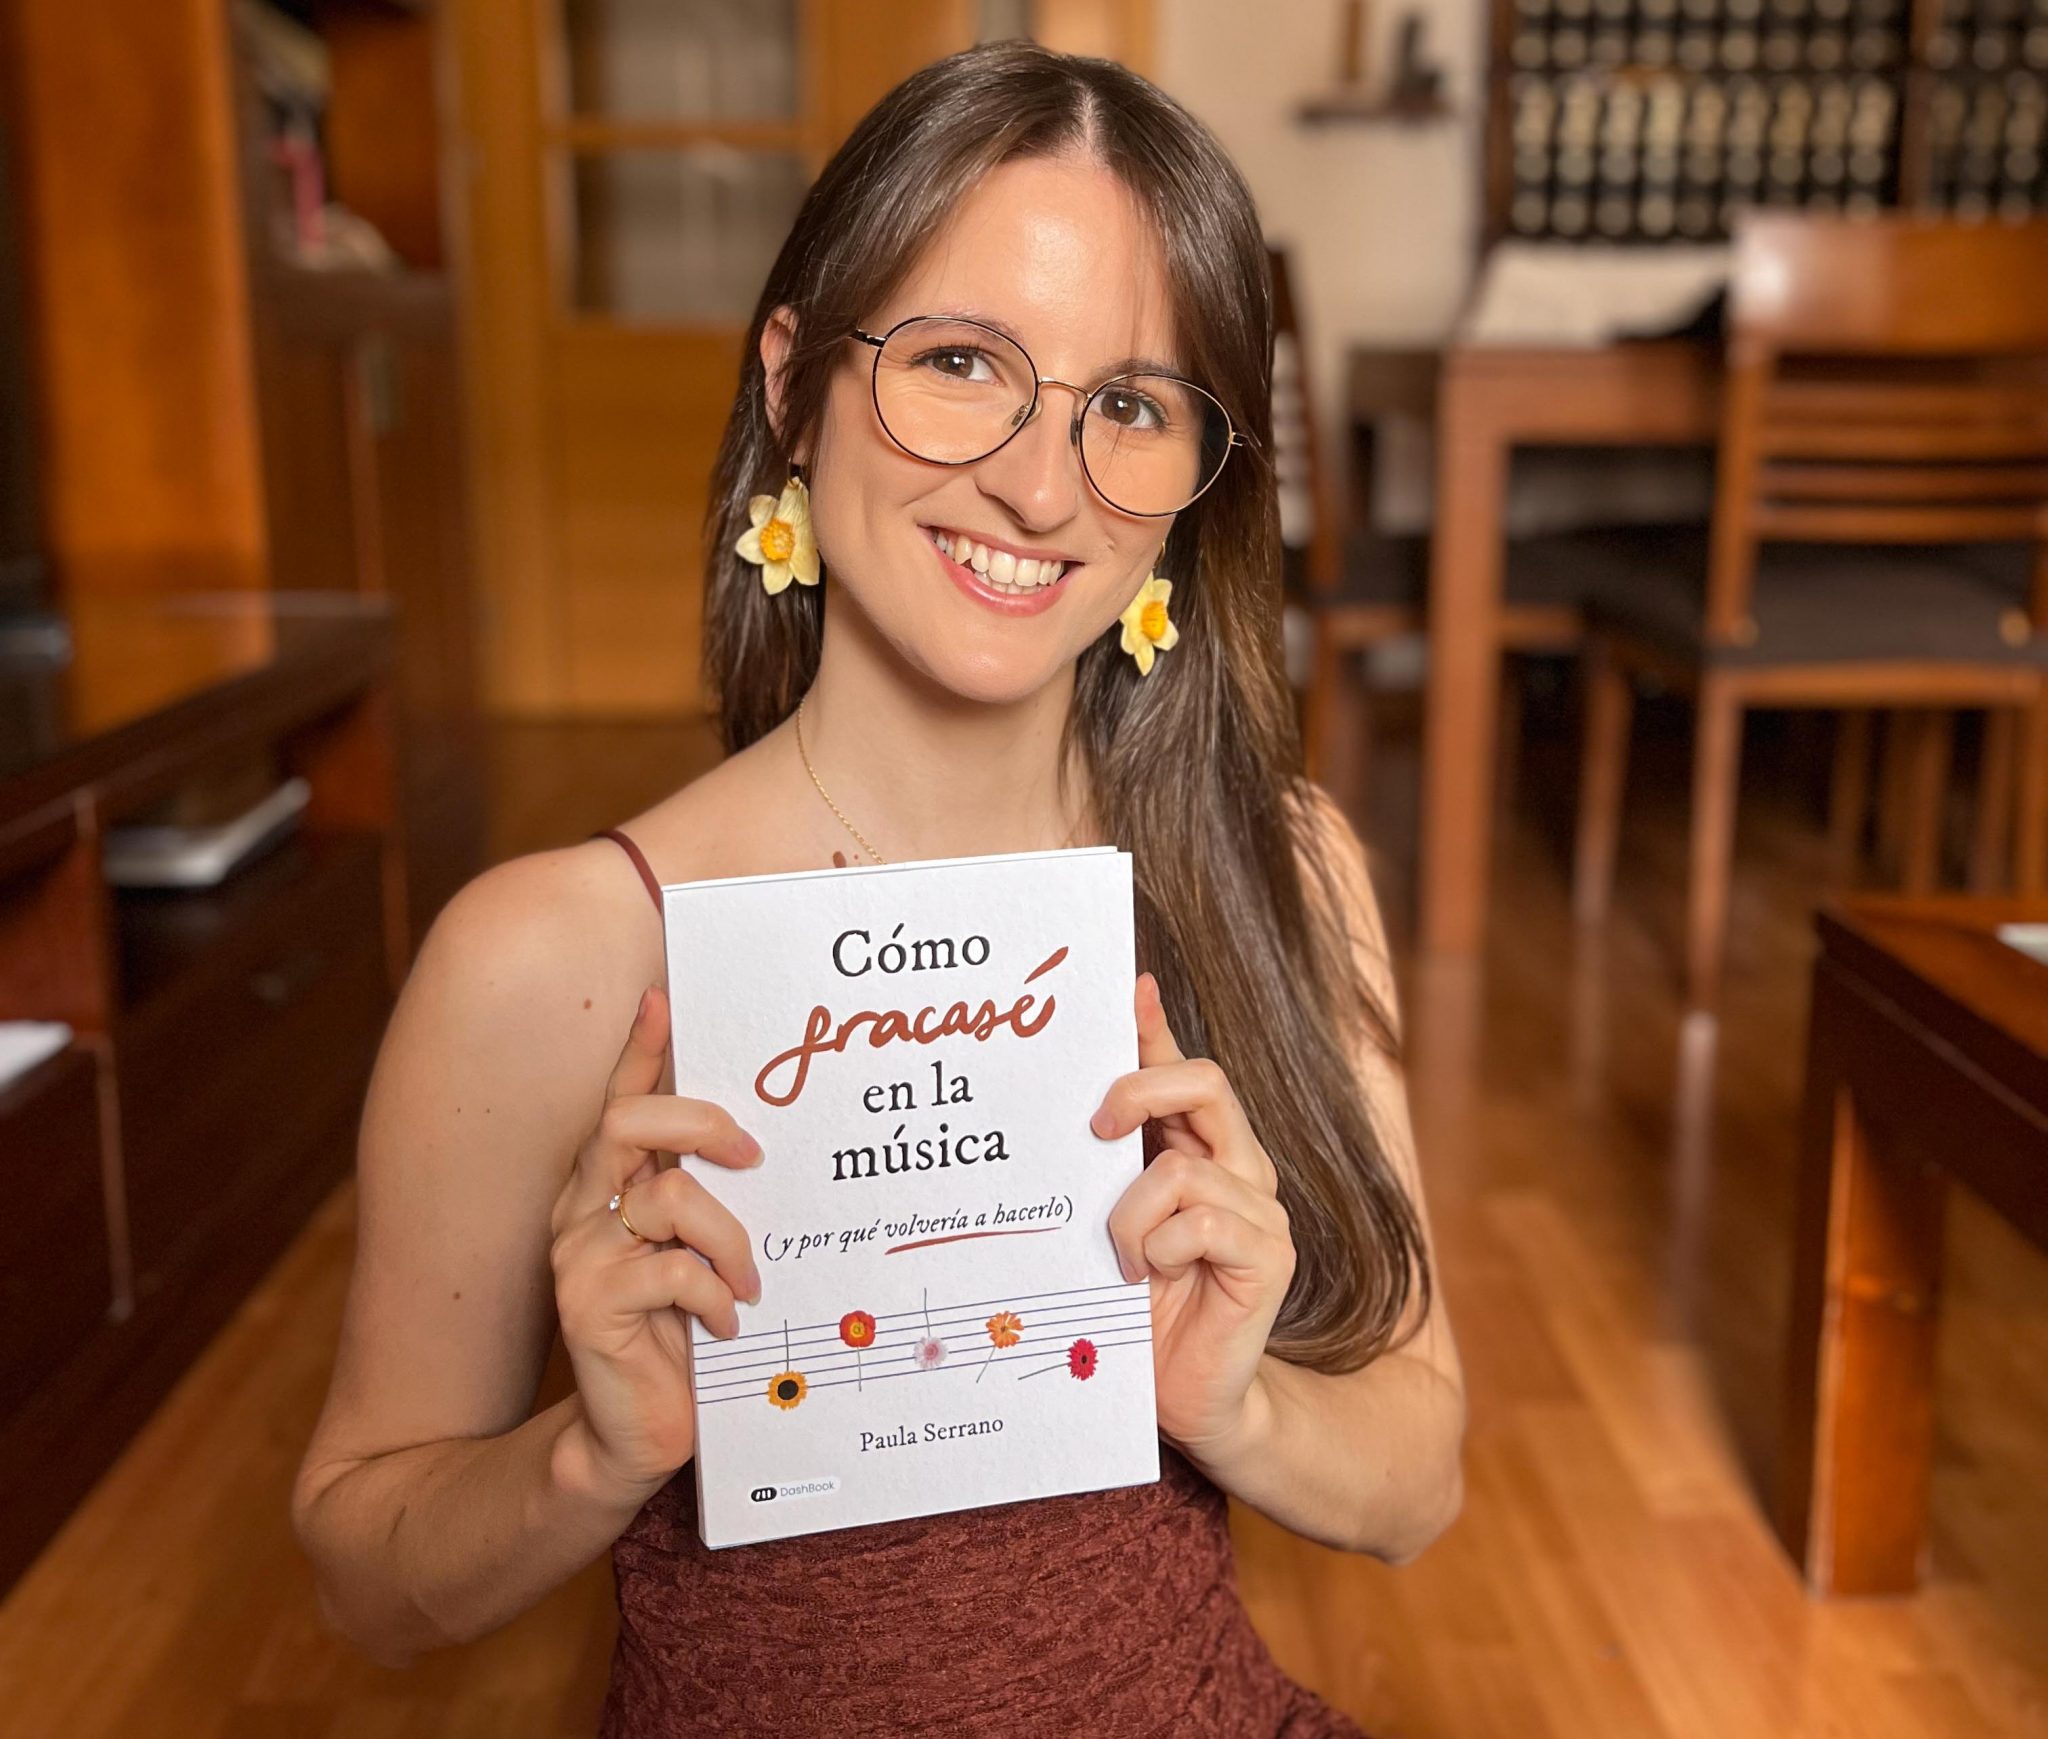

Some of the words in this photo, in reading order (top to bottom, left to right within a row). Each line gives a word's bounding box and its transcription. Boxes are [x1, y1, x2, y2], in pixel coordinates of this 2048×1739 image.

[832, 923, 991, 978] Cómo
[754, 946, 1069, 1107] fracasé
[862, 1081, 917, 1113] en
[931, 1060, 974, 1107] la
[831, 1123, 1011, 1181] música
[795, 1232, 835, 1259] por
[839, 1219, 881, 1254] qué
[884, 1207, 969, 1237] volvería
[974, 1213, 988, 1227] a
[992, 1195, 1074, 1225] hacerlo)
[860, 1424, 918, 1452] Paula
[923, 1416, 1005, 1443] Serrano
[779, 1480, 835, 1497] DashBook
